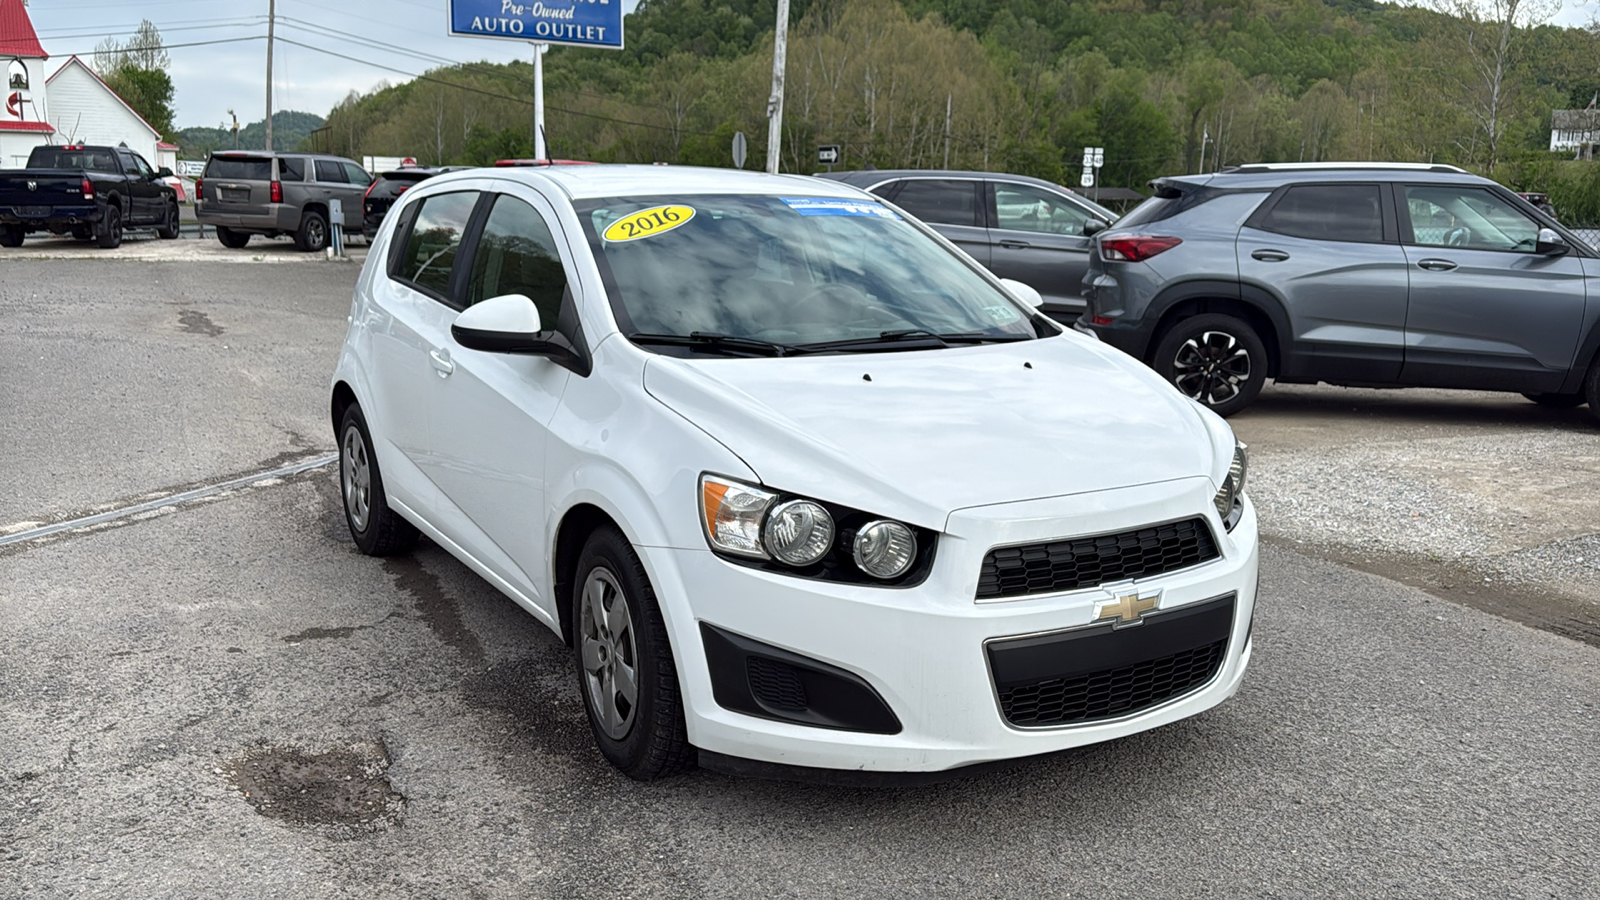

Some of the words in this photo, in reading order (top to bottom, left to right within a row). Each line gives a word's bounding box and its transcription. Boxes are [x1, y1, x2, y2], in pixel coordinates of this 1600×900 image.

[501, 0, 575, 19] Pre-Owned
[471, 16, 524, 34] AUTO
[536, 21, 606, 41] OUTLET
[620, 207, 680, 237] 2016
